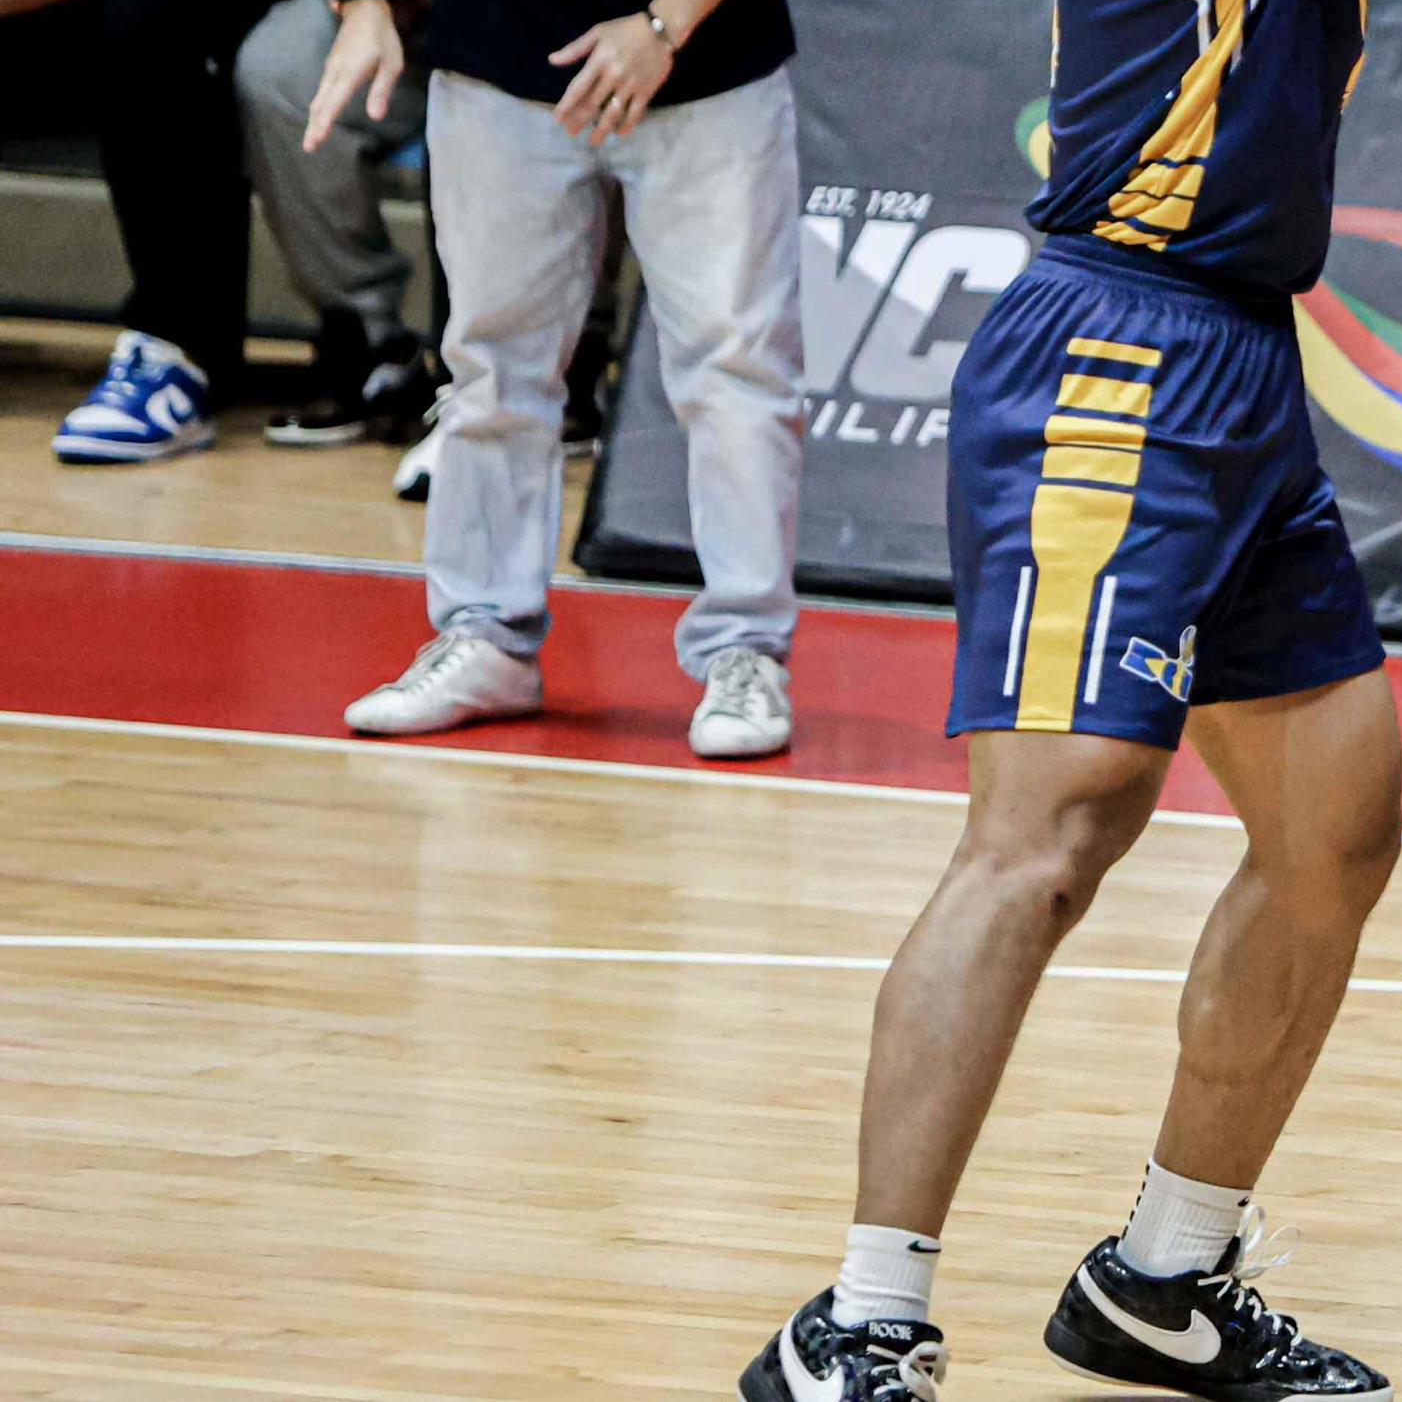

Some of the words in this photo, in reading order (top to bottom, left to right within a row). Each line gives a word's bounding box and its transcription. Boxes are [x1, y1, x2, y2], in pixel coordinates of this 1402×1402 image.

[864, 188, 933, 221] 1924
[800, 213, 1032, 398] NC
[868, 1321, 915, 1341] BOOK
